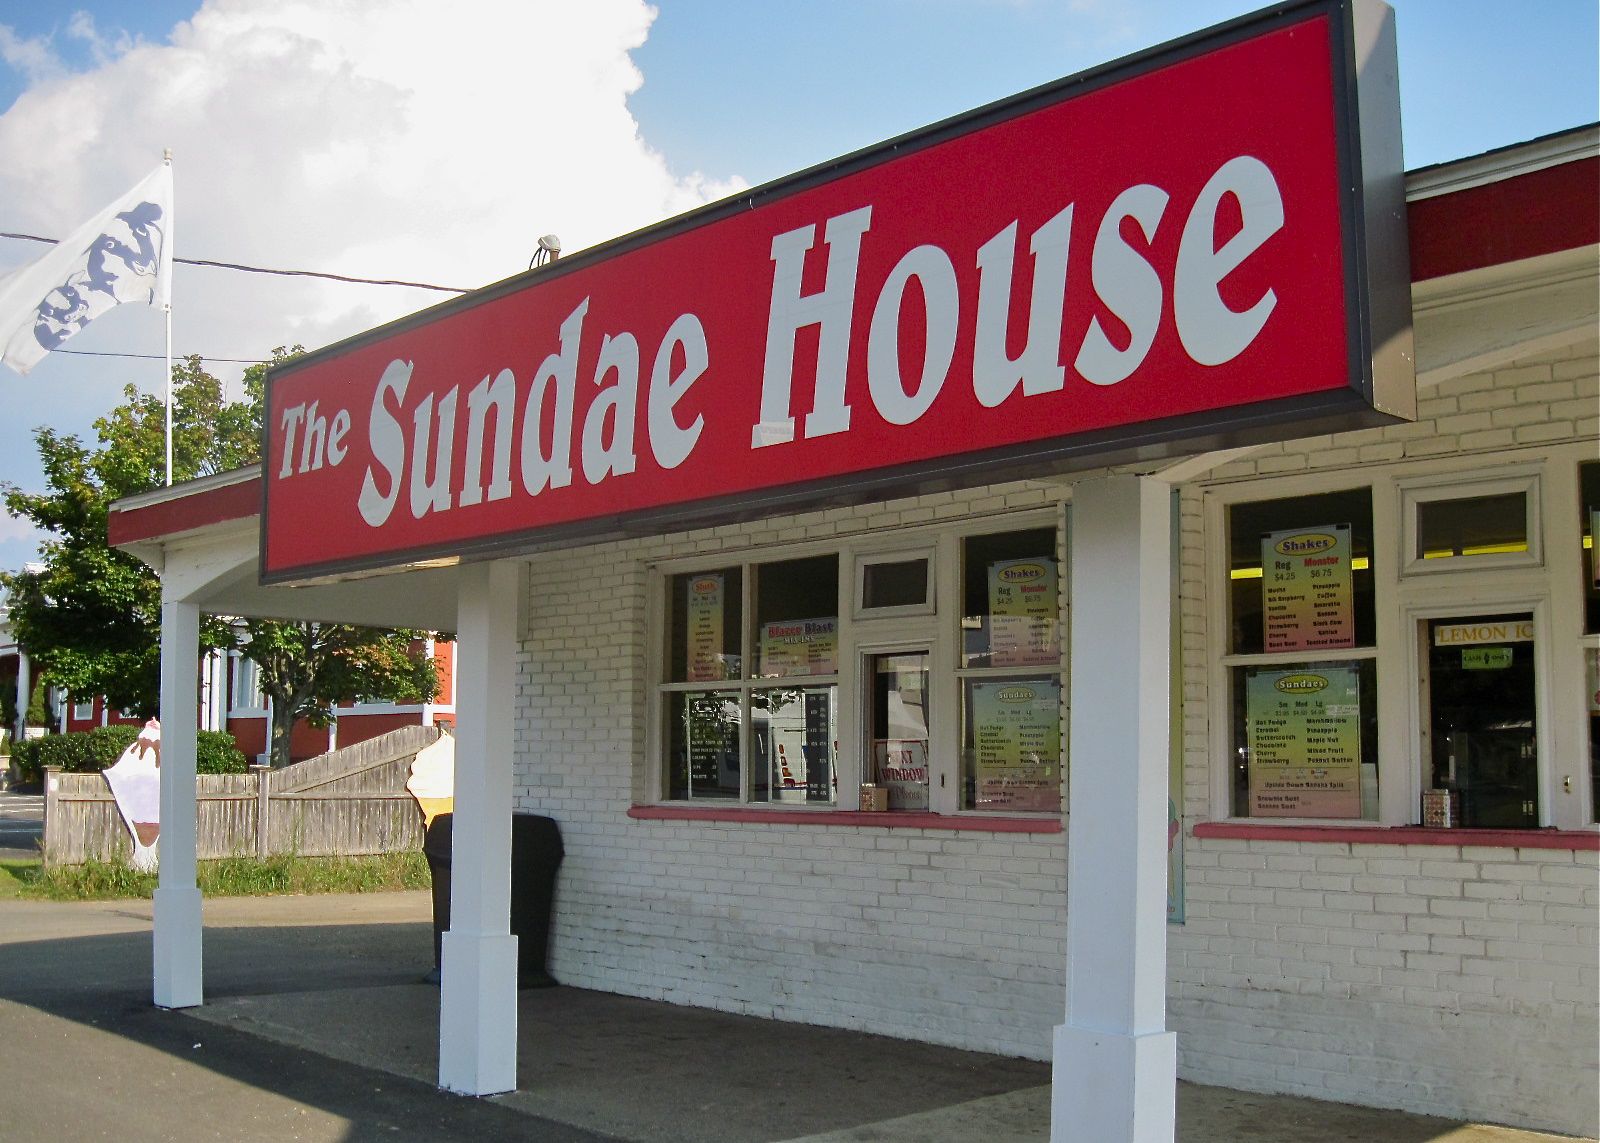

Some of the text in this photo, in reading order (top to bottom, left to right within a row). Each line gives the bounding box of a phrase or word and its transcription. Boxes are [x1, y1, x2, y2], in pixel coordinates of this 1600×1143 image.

[279, 155, 1285, 527] The Sundae House
[1282, 539, 1328, 551] Shakes
[1275, 561, 1291, 570] Reg
[1304, 556, 1339, 567] Monster
[1004, 569, 1040, 579] Shakes
[1274, 572, 1296, 582] $4.25
[1310, 569, 1332, 578] $6.75
[998, 586, 1011, 596] Reg
[805, 622, 834, 635] Blast
[1439, 626, 1507, 643] LEMON
[1279, 680, 1324, 689] Sundaes
[998, 691, 1032, 699] Sundaes
[881, 768, 924, 781] WINDOW
